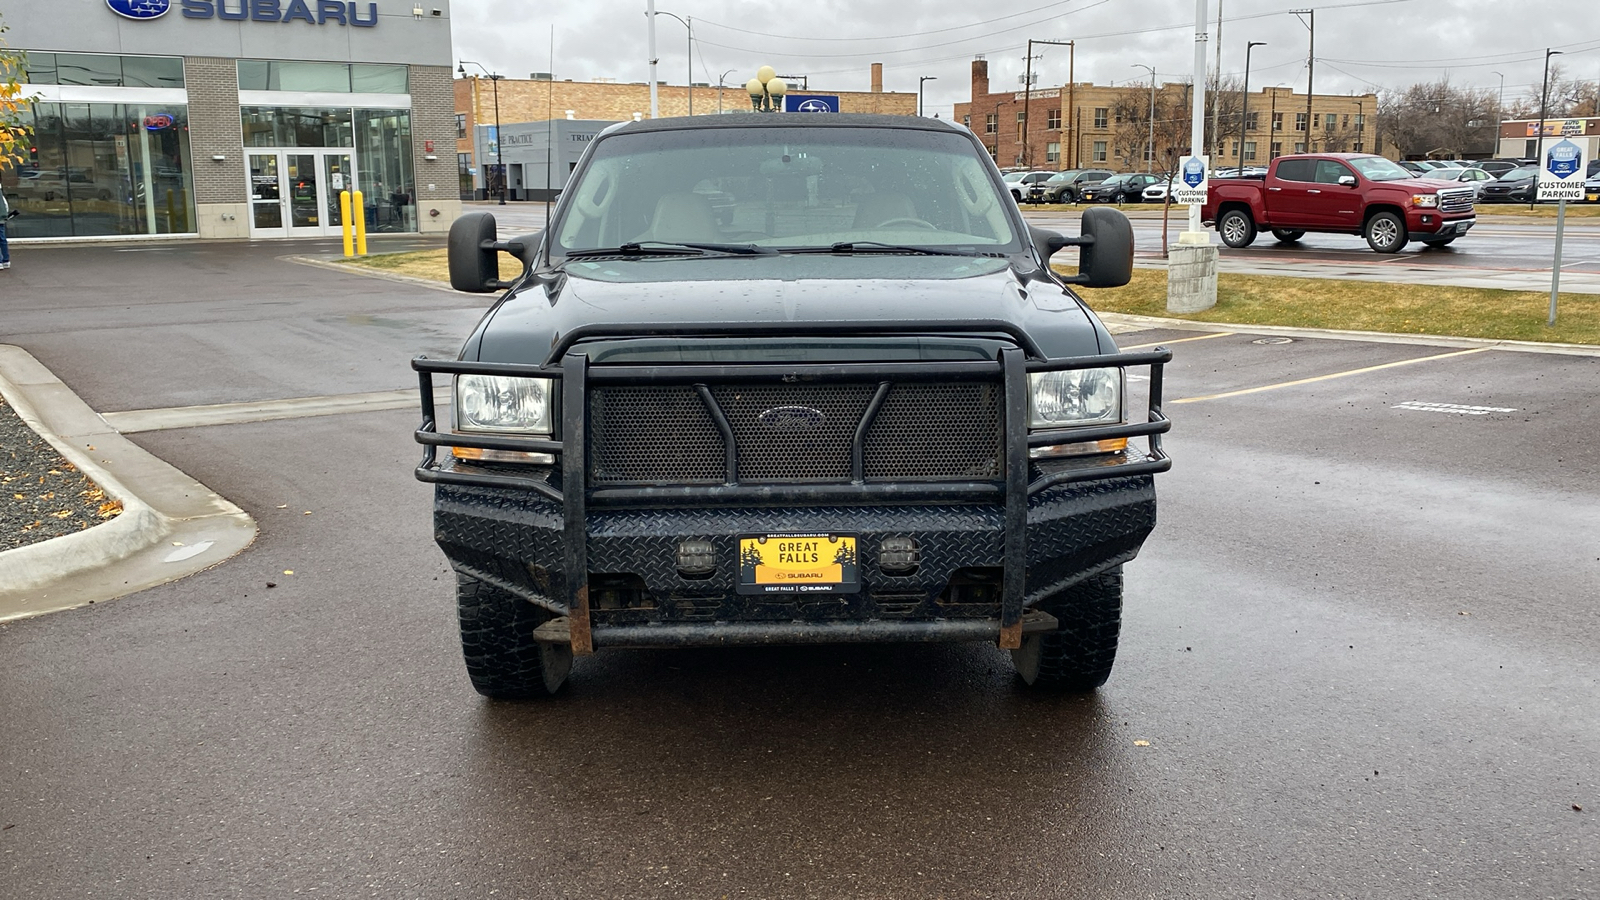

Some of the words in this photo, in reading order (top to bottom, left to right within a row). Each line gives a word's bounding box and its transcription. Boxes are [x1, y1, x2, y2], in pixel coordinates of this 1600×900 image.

[182, 0, 378, 27] SUBARU
[143, 116, 171, 127] OPEN
[508, 135, 533, 144] PRACTICE
[1539, 181, 1586, 189] CUSTOMER
[1541, 190, 1580, 198] PARKING
[778, 542, 819, 552] GREAT
[779, 553, 819, 563] FALLS
